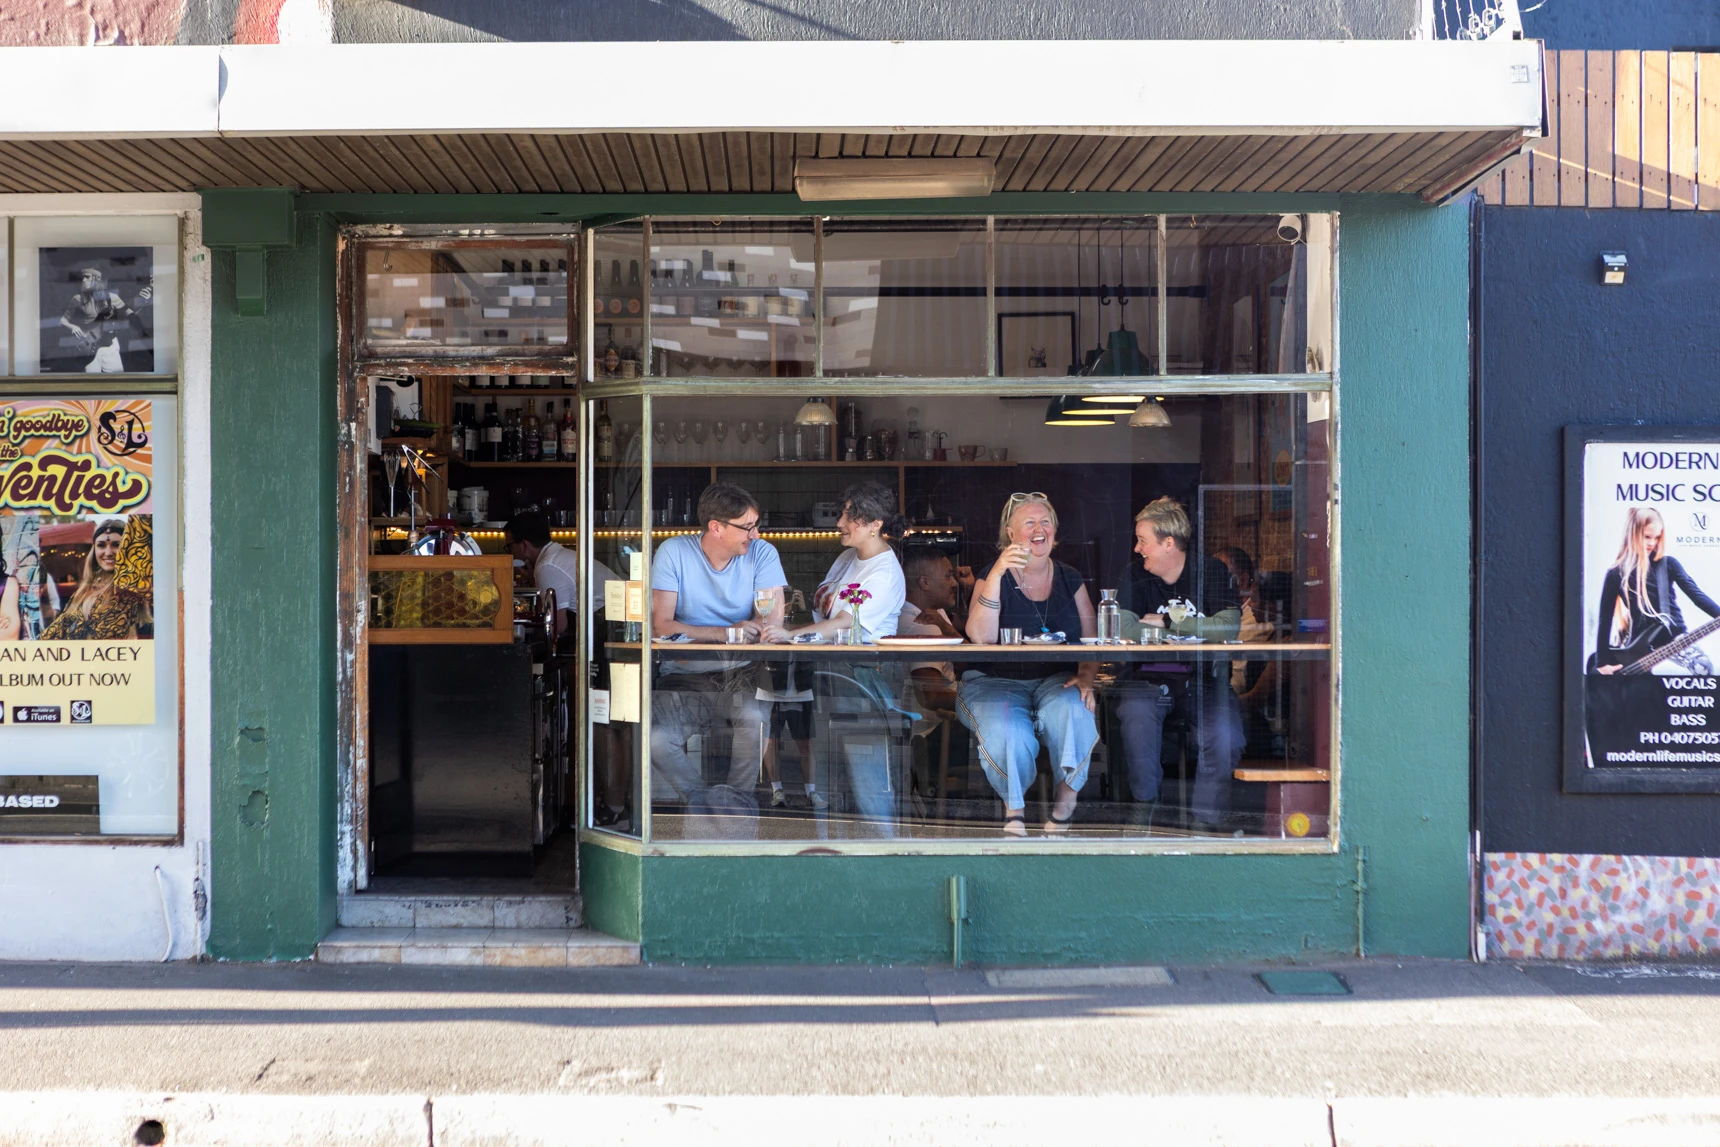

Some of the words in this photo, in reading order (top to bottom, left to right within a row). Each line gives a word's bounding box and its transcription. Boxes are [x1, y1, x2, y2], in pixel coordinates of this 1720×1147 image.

[12, 412, 86, 441] goodbye
[1622, 451, 1719, 470] MODERN
[1616, 483, 1686, 502] MUSIC
[0, 647, 26, 662] AN
[32, 647, 71, 662] AND
[80, 646, 142, 662] LACEY
[0, 673, 44, 687] LBUM
[49, 673, 85, 687] OUT
[89, 673, 132, 687] NOW
[1661, 677, 1717, 690] VOCALS
[1667, 695, 1715, 708] GUITAR
[31, 713, 57, 721] iTunes
[1669, 713, 1707, 726] BASS
[1639, 731, 1659, 744] PH
[1660, 731, 1720, 745] 0407505
[1606, 749, 1720, 763] modernlifemusics
